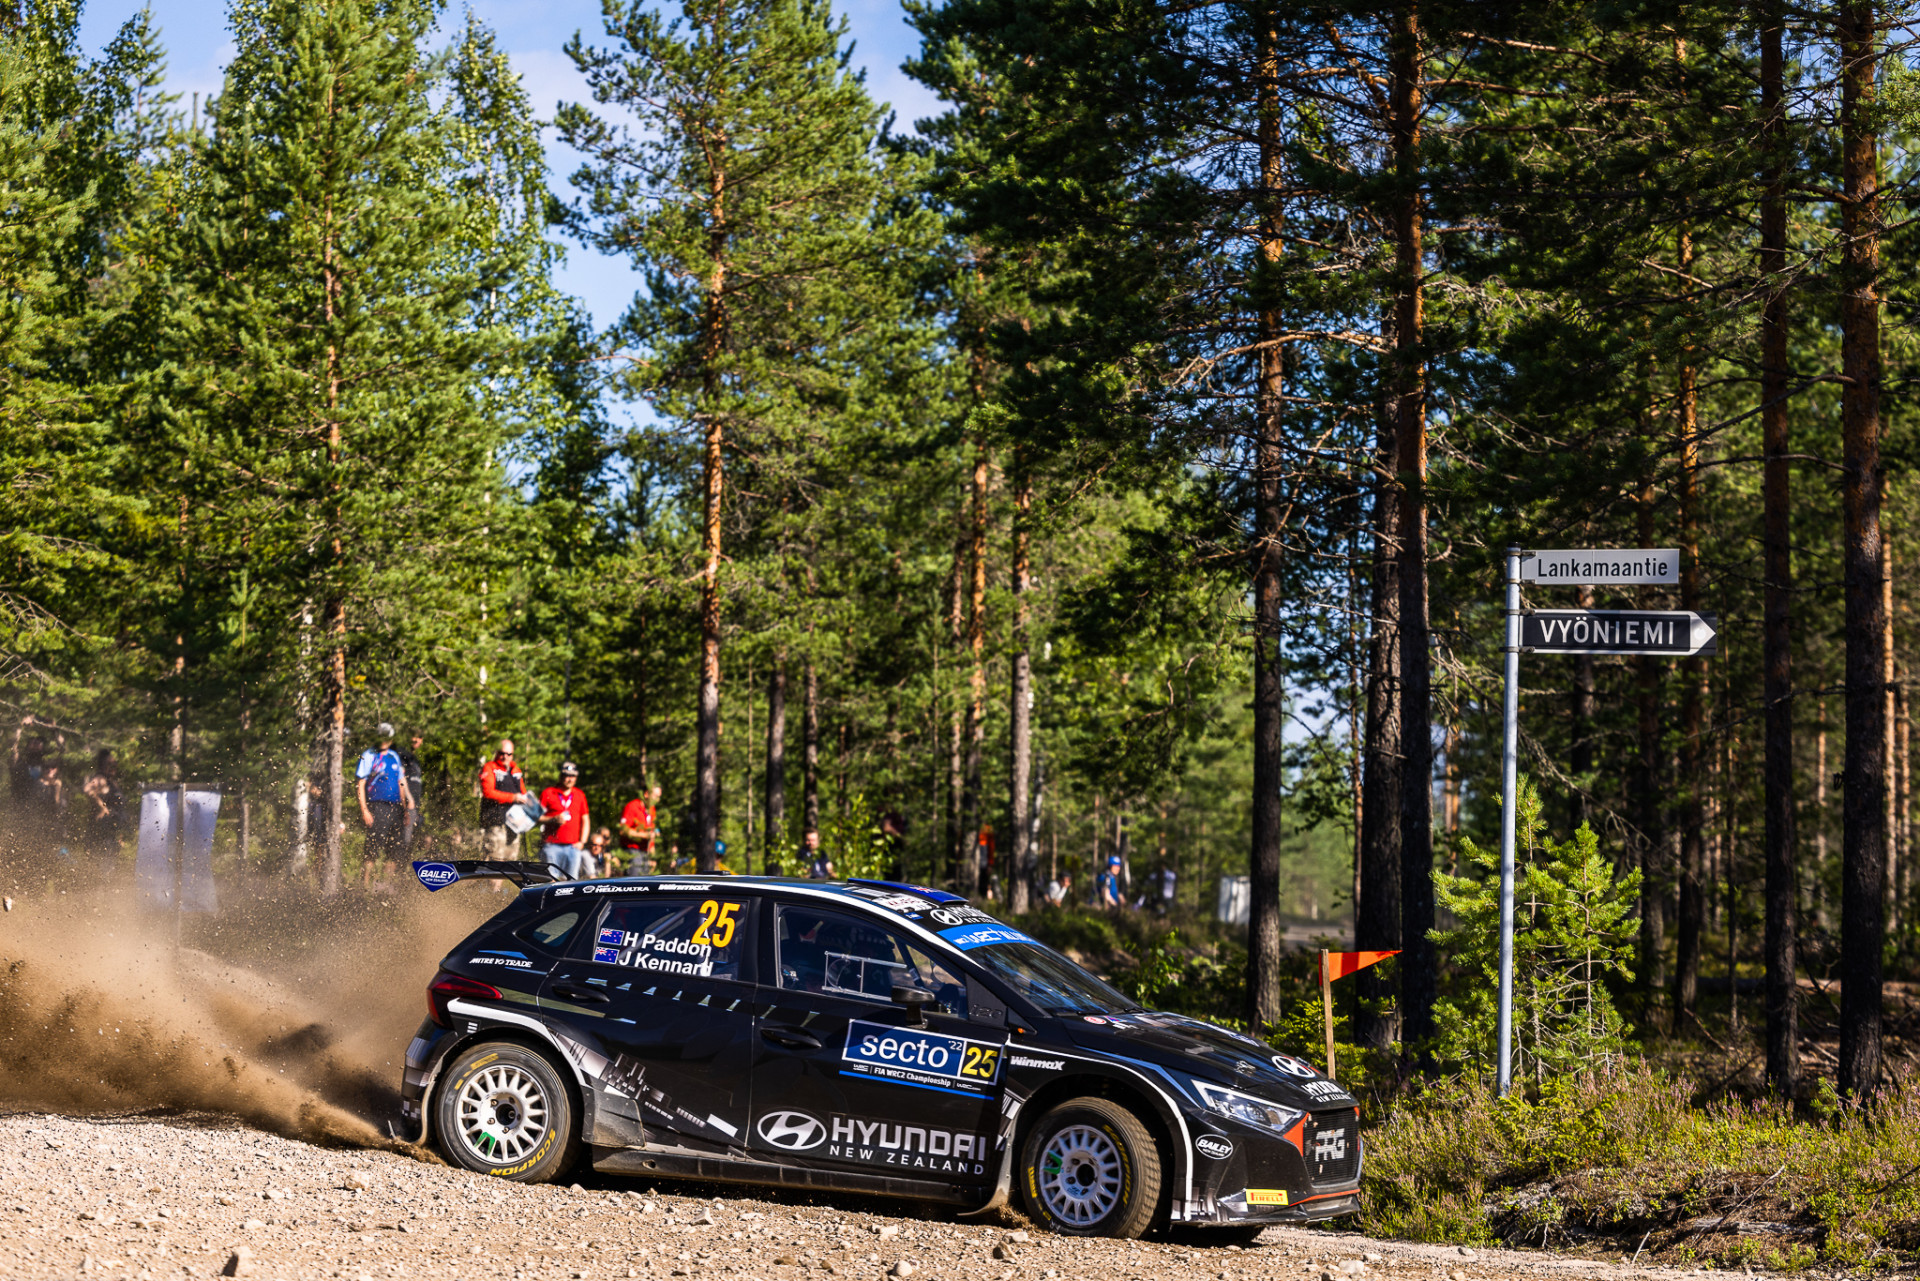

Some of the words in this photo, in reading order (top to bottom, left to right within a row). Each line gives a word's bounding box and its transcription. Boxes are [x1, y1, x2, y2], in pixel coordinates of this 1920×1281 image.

[1537, 557, 1668, 578] Lankamaantie
[1539, 616, 1674, 645] VYÖNIEMI
[420, 869, 454, 880] BAILEY
[691, 899, 741, 948] 25
[623, 931, 639, 947] H
[641, 934, 712, 957] Paddon
[469, 957, 495, 965] MITRE
[503, 959, 533, 968] TRADE
[618, 951, 631, 966] J
[634, 953, 714, 977] Kennard
[860, 1034, 949, 1068] secto
[962, 1047, 999, 1079] 25
[874, 1067, 885, 1076] FIA
[886, 1070, 905, 1079] WRC2
[906, 1073, 951, 1087] Championship
[831, 1116, 986, 1161] HYUNDAI
[1198, 1138, 1232, 1154] BAILEY
[490, 1128, 556, 1176] SCORPION
[829, 1145, 873, 1160] NEW
[886, 1152, 984, 1175] ZEALAND
[1250, 1192, 1284, 1203] PIRELLI
